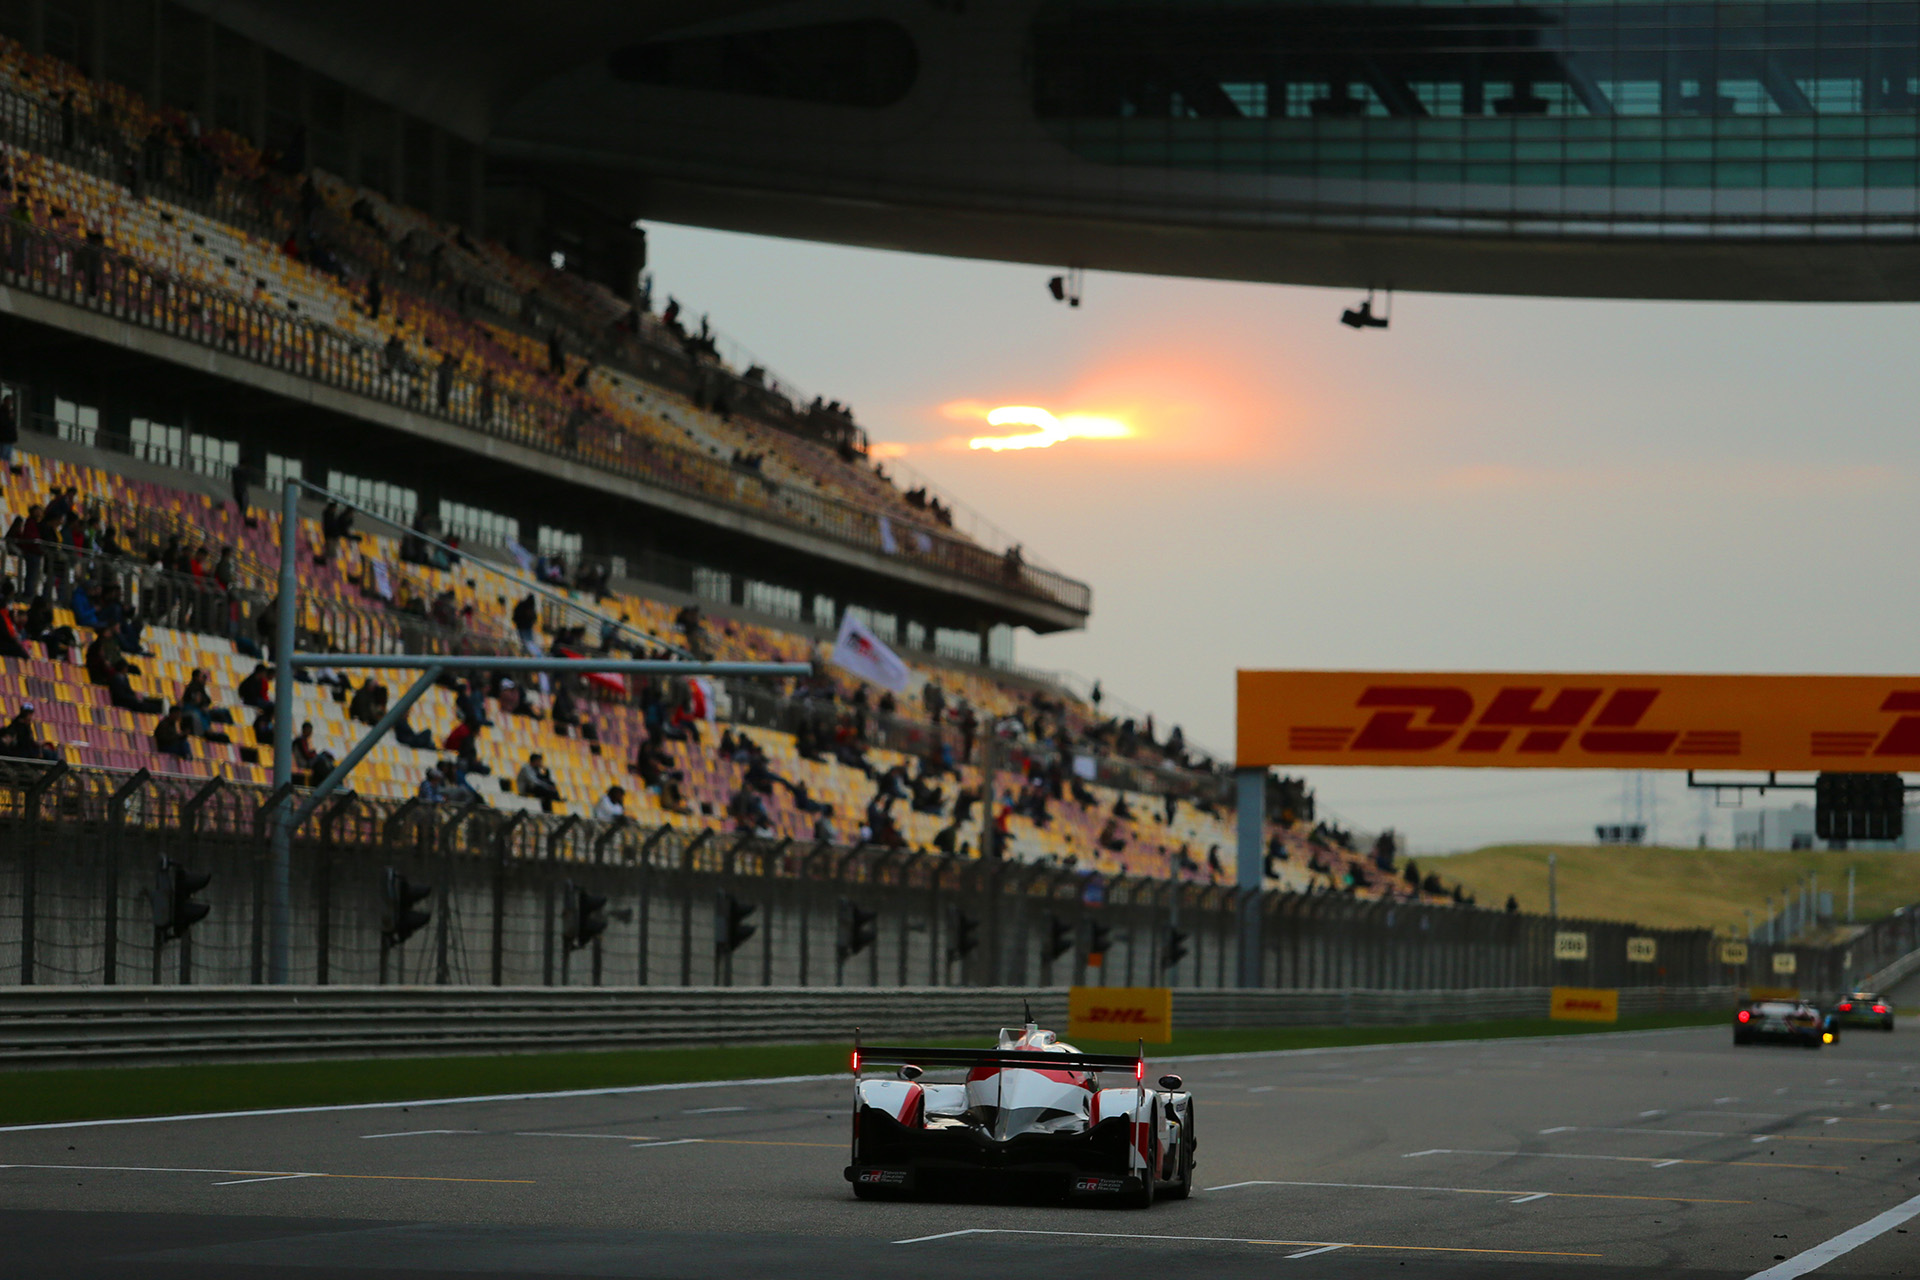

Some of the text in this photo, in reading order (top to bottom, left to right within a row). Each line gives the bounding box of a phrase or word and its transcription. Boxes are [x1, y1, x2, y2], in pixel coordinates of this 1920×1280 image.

[1350, 686, 1679, 754] DHL
[1088, 1007, 1145, 1024] DHL
[860, 1174, 881, 1182] GR
[1077, 1182, 1097, 1190] GR
